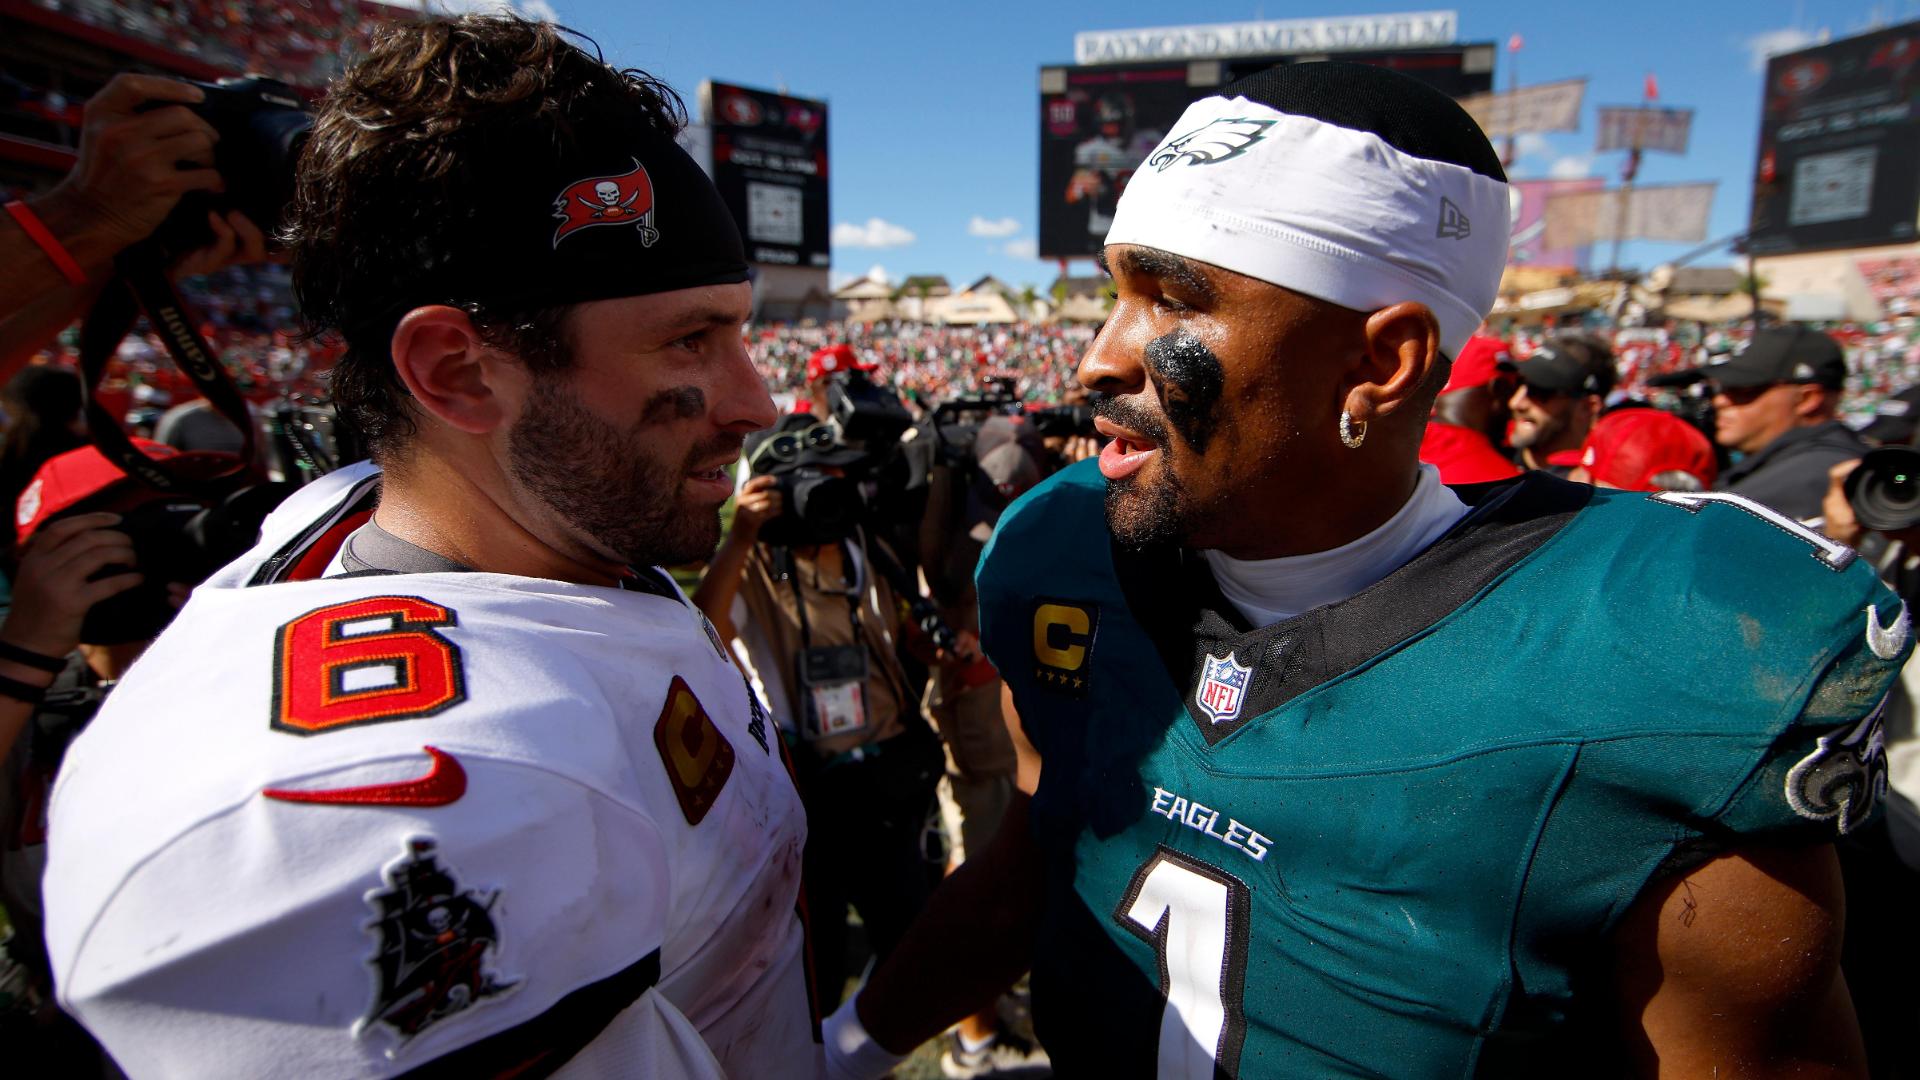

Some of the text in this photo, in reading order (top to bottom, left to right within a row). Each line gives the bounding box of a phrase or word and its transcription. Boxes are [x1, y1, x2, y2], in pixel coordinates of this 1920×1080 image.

[1083, 19, 1452, 63] RAYMOND JAMES STADIUM
[159, 306, 216, 382] Canon
[270, 595, 467, 737] 6
[1034, 604, 1089, 670] C
[1203, 681, 1236, 713] NFL
[665, 690, 718, 788] C
[1151, 787, 1275, 863] EAGLES
[1114, 844, 1251, 1080] 1
